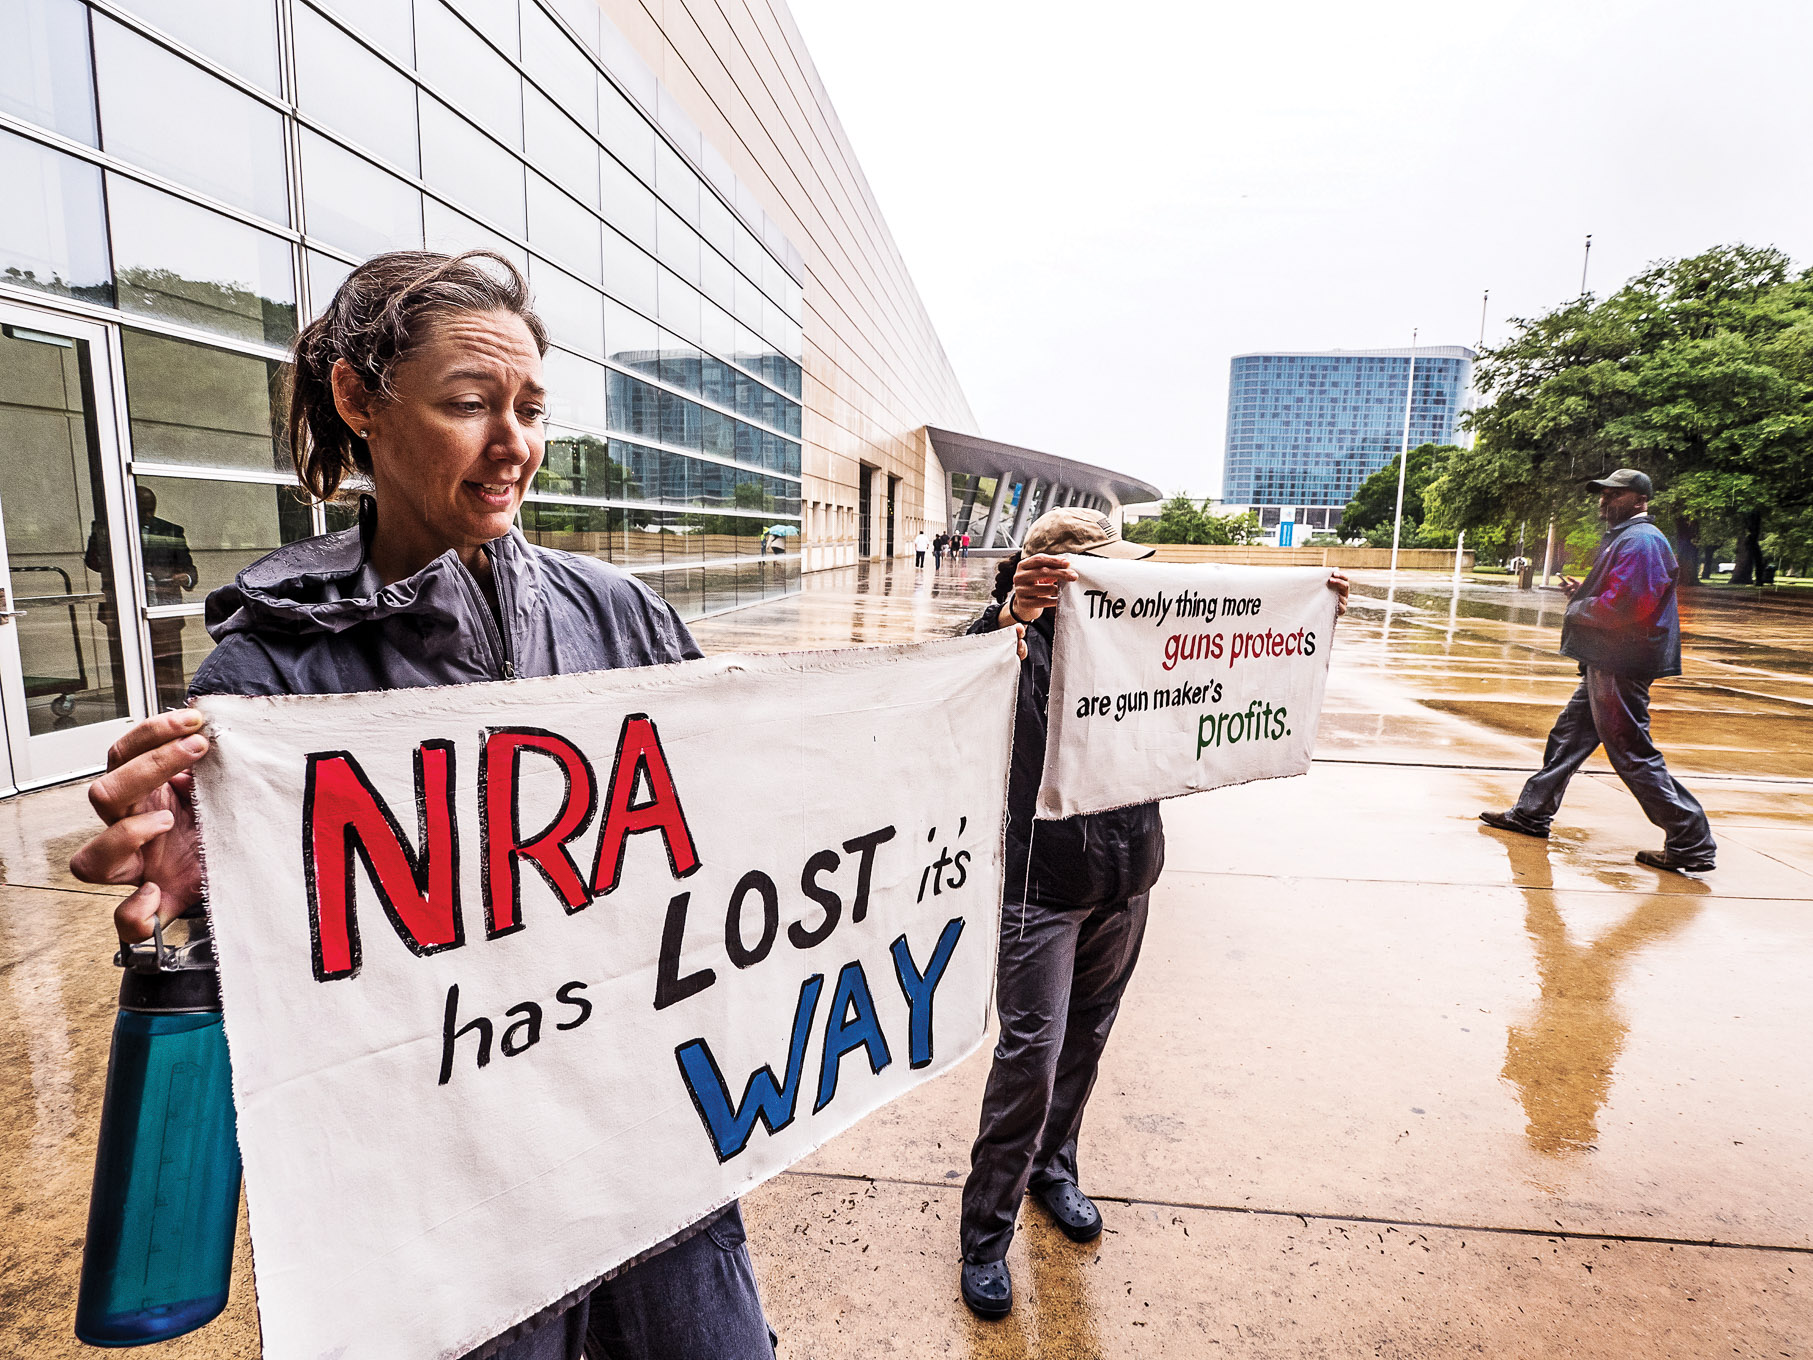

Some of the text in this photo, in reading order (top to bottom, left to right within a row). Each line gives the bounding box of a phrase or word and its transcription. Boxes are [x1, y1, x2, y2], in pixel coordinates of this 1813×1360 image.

[1083, 589, 1262, 627] The only thing more
[1161, 626, 1316, 671] guns protects
[1076, 678, 1223, 722] are gun maker's
[1196, 699, 1292, 761] profits.
[301, 712, 704, 984] NRA
[438, 815, 971, 1086] has LOST it's
[674, 916, 966, 1166] WAY
